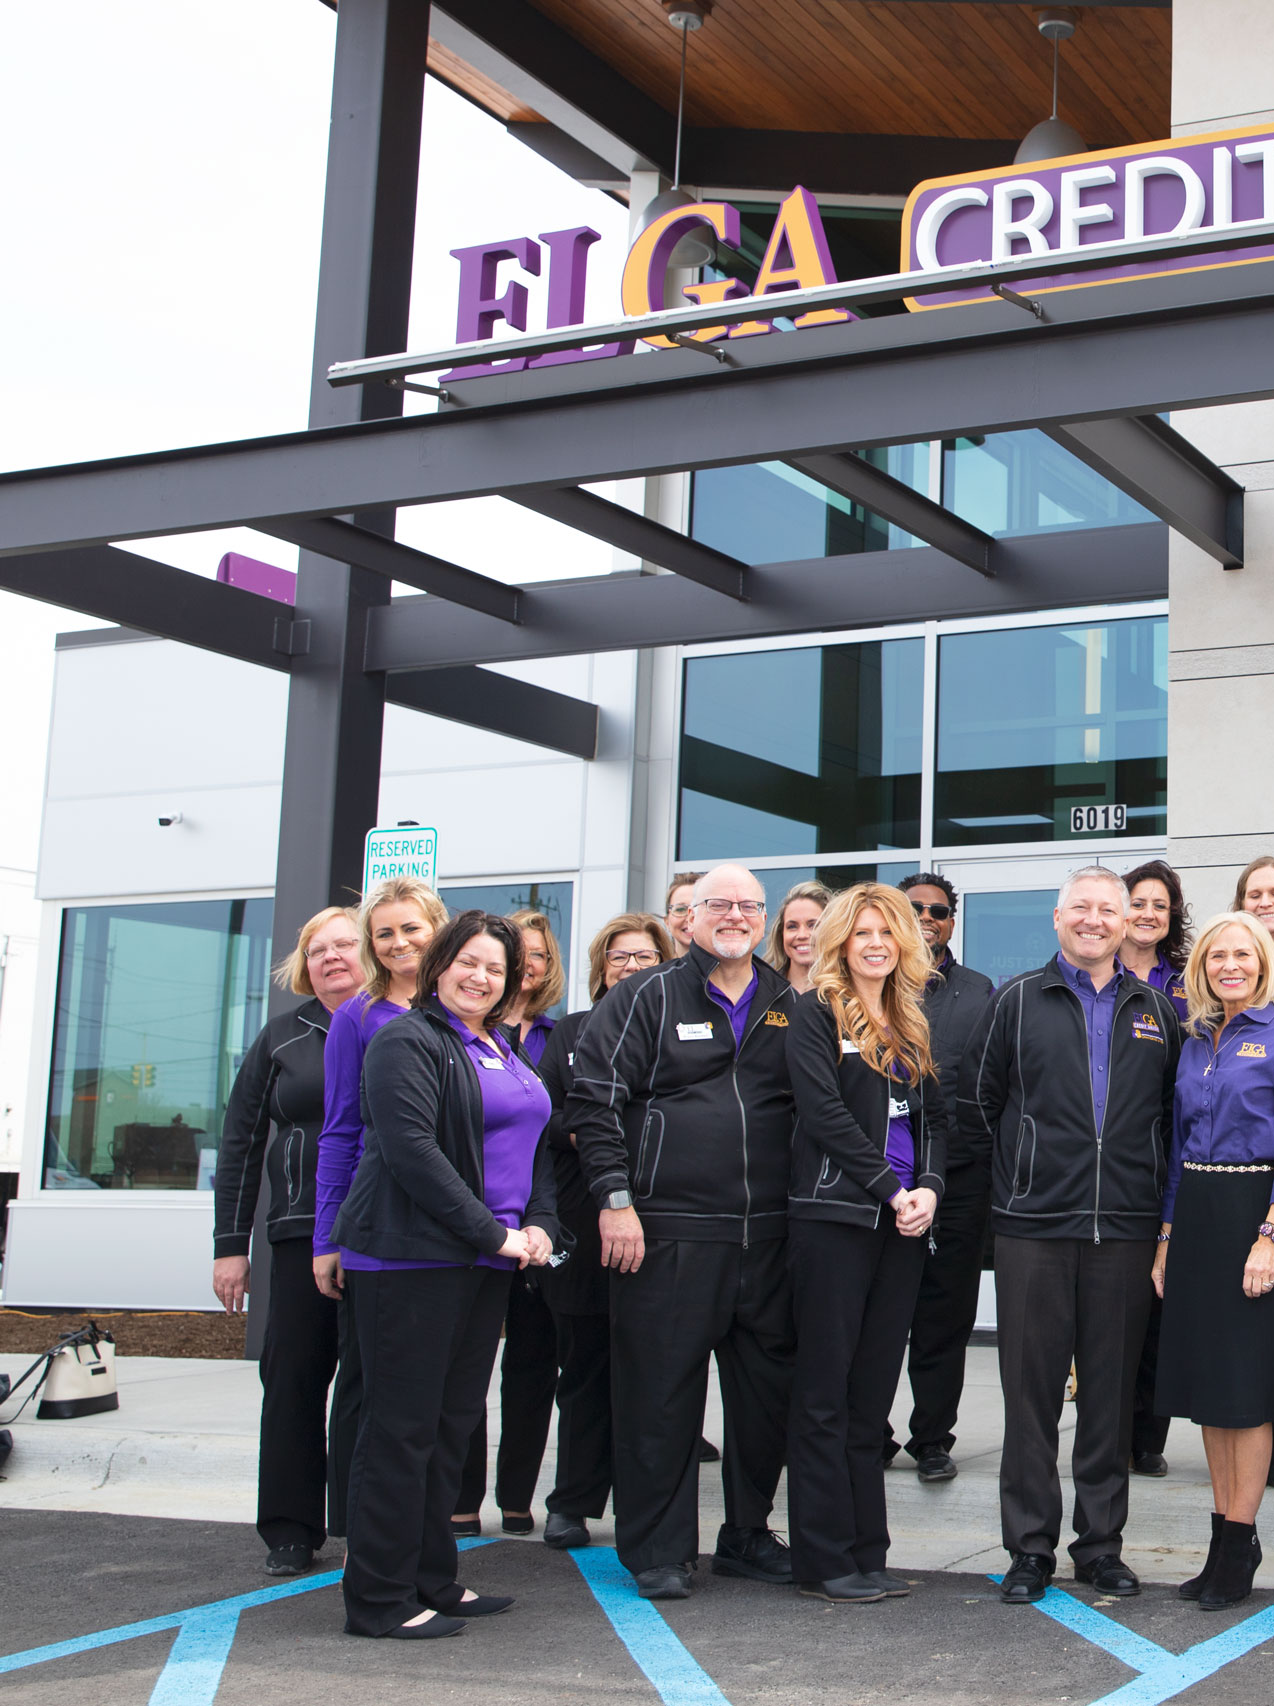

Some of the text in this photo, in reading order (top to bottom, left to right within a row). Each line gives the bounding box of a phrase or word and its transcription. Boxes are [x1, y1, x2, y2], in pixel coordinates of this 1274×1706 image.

[438, 185, 858, 383] ELGA
[1072, 805, 1125, 831] 6019
[370, 839, 434, 858] RESERVED
[372, 861, 429, 879] PARKING
